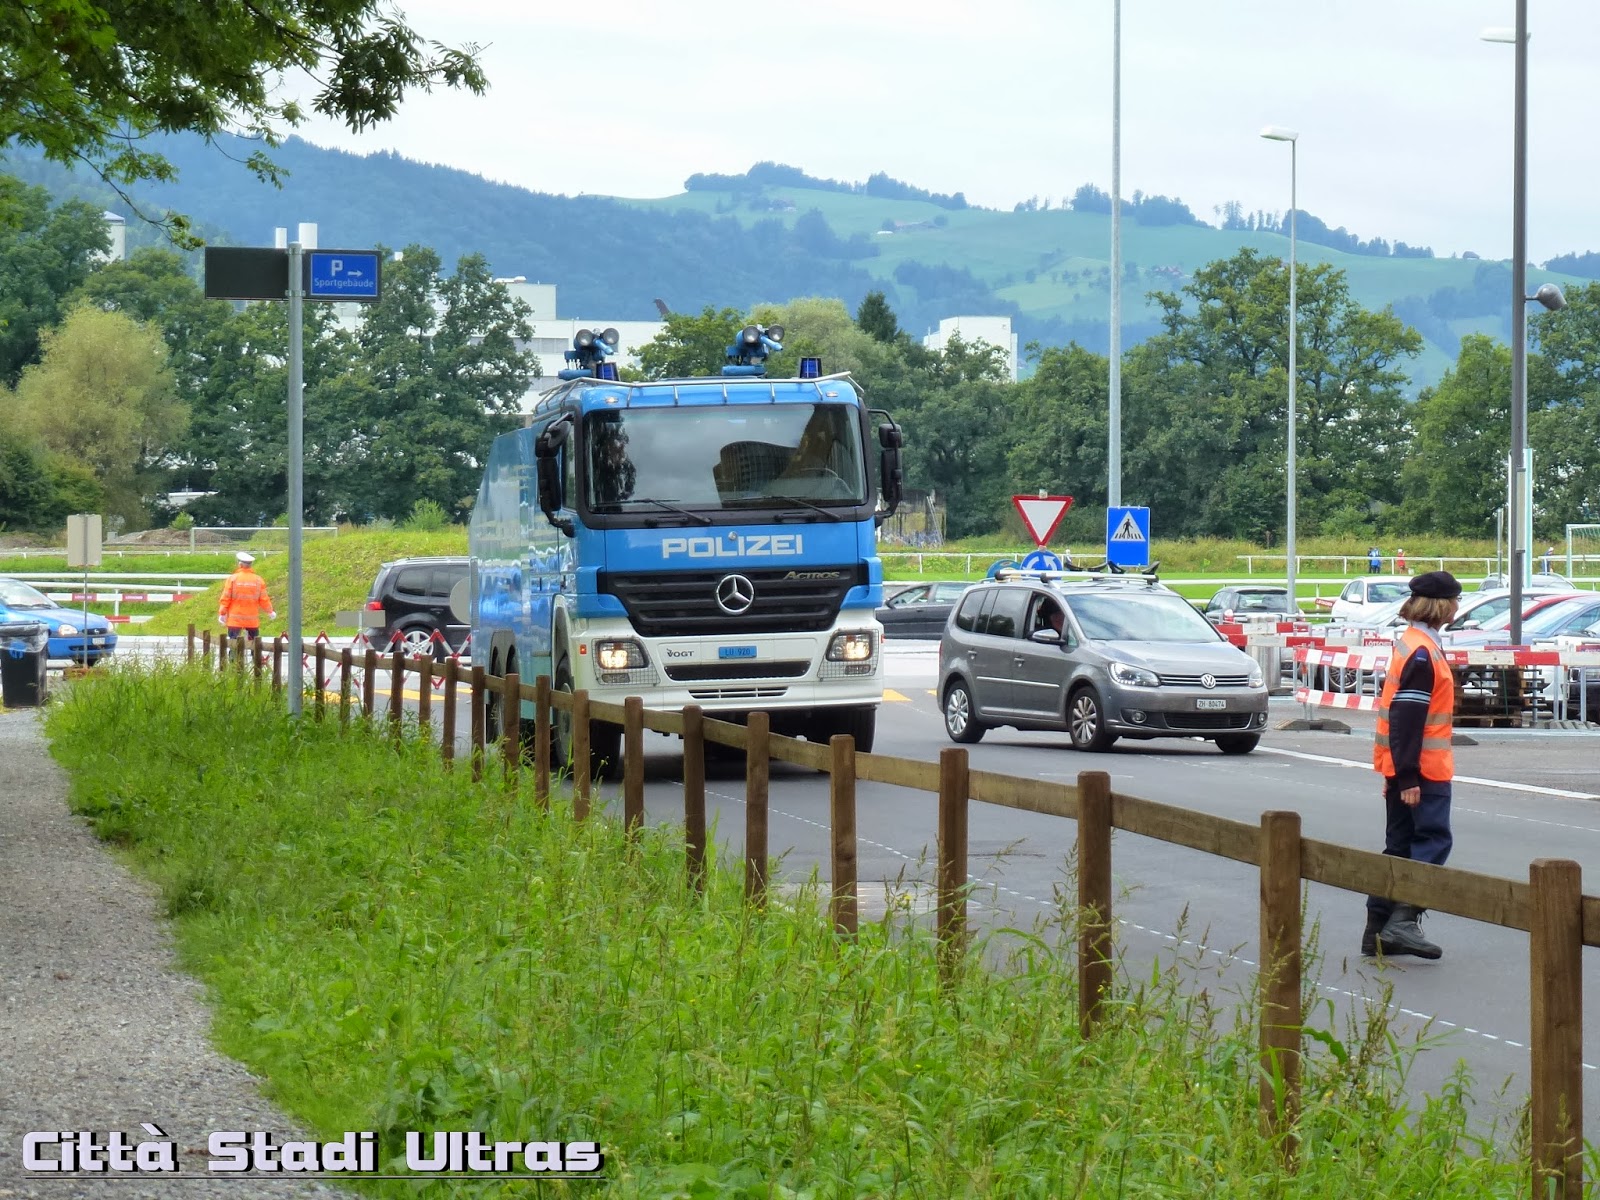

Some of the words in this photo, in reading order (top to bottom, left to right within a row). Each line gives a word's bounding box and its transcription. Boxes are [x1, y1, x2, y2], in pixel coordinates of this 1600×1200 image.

[331, 260, 343, 276] P
[314, 277, 374, 288] Sportgebäude
[662, 534, 803, 559] POLIZEI
[666, 649, 694, 658] VOGT
[1198, 700, 1206, 708] ZH
